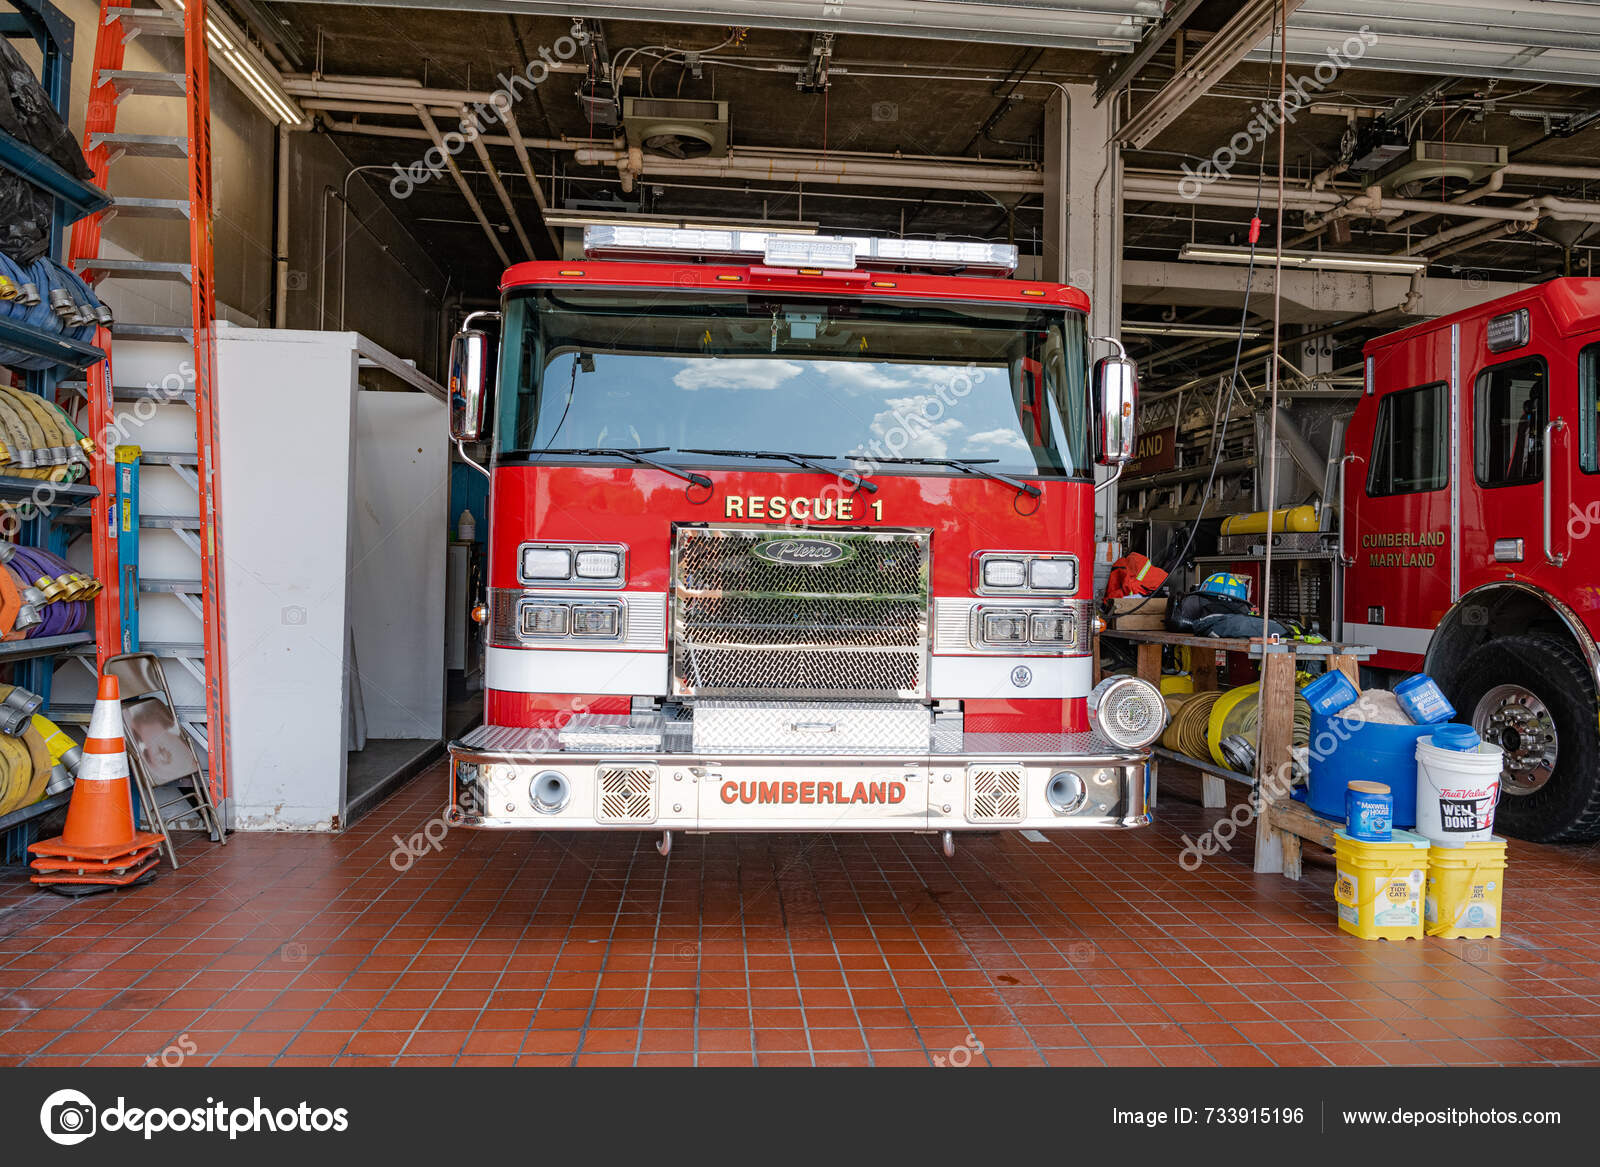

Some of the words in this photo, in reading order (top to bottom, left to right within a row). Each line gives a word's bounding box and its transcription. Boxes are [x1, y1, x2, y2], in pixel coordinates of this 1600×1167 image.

[725, 495, 853, 521] RESCUE
[870, 499, 883, 521] 1
[1362, 532, 1445, 548] CUMBERLAND
[777, 542, 832, 559] Pierce
[1369, 553, 1435, 568] MARYLAND
[720, 781, 906, 804] CUMBERLAND
[1439, 788, 1461, 799] True
[1442, 804, 1472, 816] WELL
[1445, 816, 1475, 828] DONE
